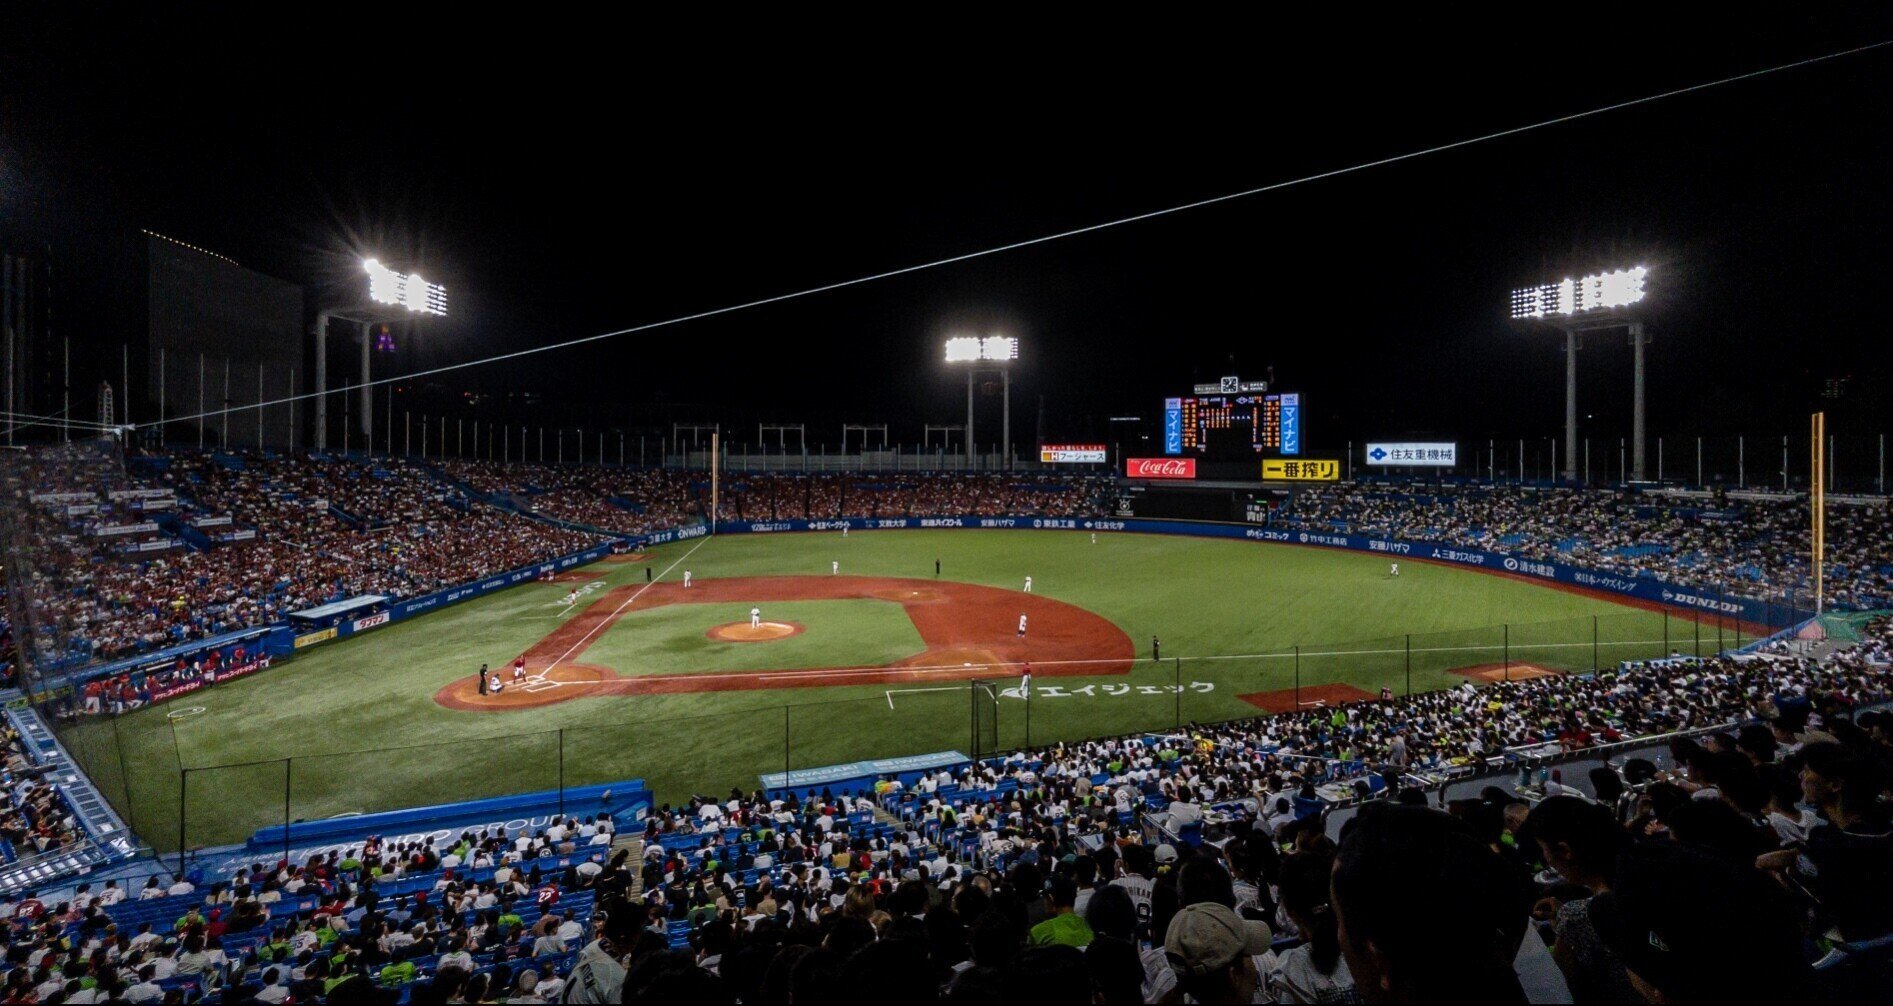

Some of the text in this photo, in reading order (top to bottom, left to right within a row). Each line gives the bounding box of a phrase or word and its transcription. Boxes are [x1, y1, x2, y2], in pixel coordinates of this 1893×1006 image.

[1167, 410, 1178, 452] マイナビ
[1284, 407, 1296, 452] マイナビ
[1060, 453, 1104, 461] フージャース
[1391, 449, 1453, 460] 住友重機械
[1139, 460, 1186, 475] Coca-Cola
[1267, 462, 1333, 478] 一番搾り
[678, 526, 707, 539] ONWARD
[1094, 521, 1125, 530] 住友化学
[1309, 535, 1347, 546] 竹中工務店
[1369, 540, 1410, 554] 安藤ハザマ
[1441, 548, 1484, 564] 三菱ガス化学
[1519, 561, 1555, 578] 清水建設
[1674, 593, 1744, 614] DUNLOP
[1037, 681, 1215, 698] エイジェック
[792, 764, 858, 778] IWASAKI
[461, 814, 566, 840] GROUP
